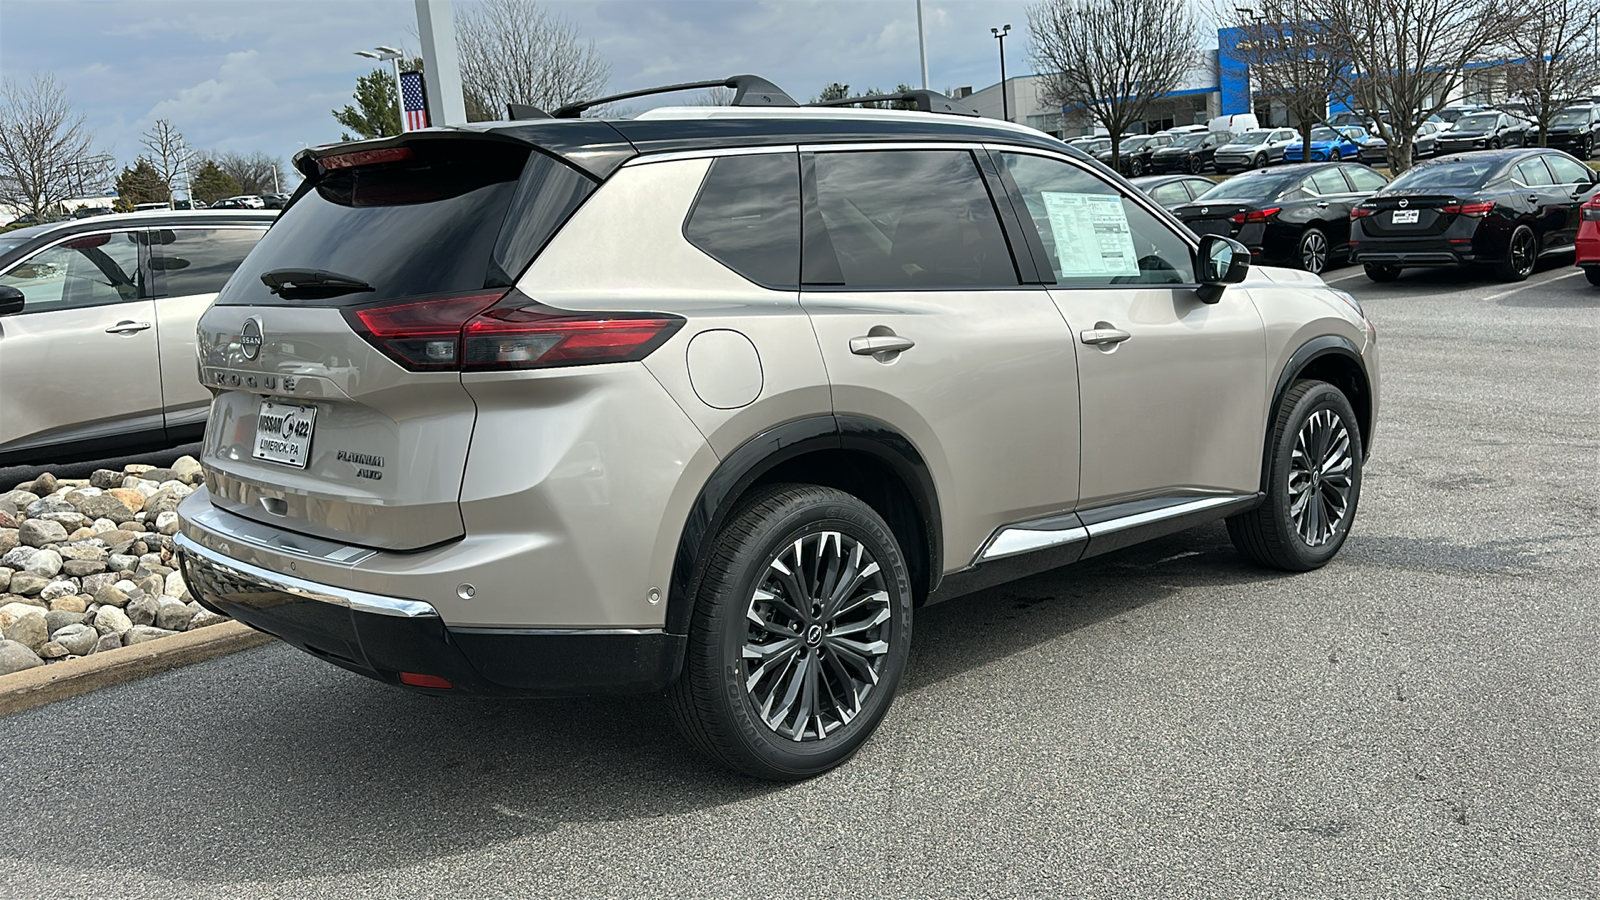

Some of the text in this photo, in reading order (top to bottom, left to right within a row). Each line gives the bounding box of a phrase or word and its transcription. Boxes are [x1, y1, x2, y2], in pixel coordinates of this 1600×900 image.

[240, 336, 261, 345] SSAN
[214, 372, 296, 391] ROGUE
[258, 414, 310, 437] NISSAN 422
[289, 443, 299, 455] PA
[336, 449, 385, 467] PLATINUM
[356, 468, 382, 481] AWD
[726, 665, 768, 748] DUNLOP
